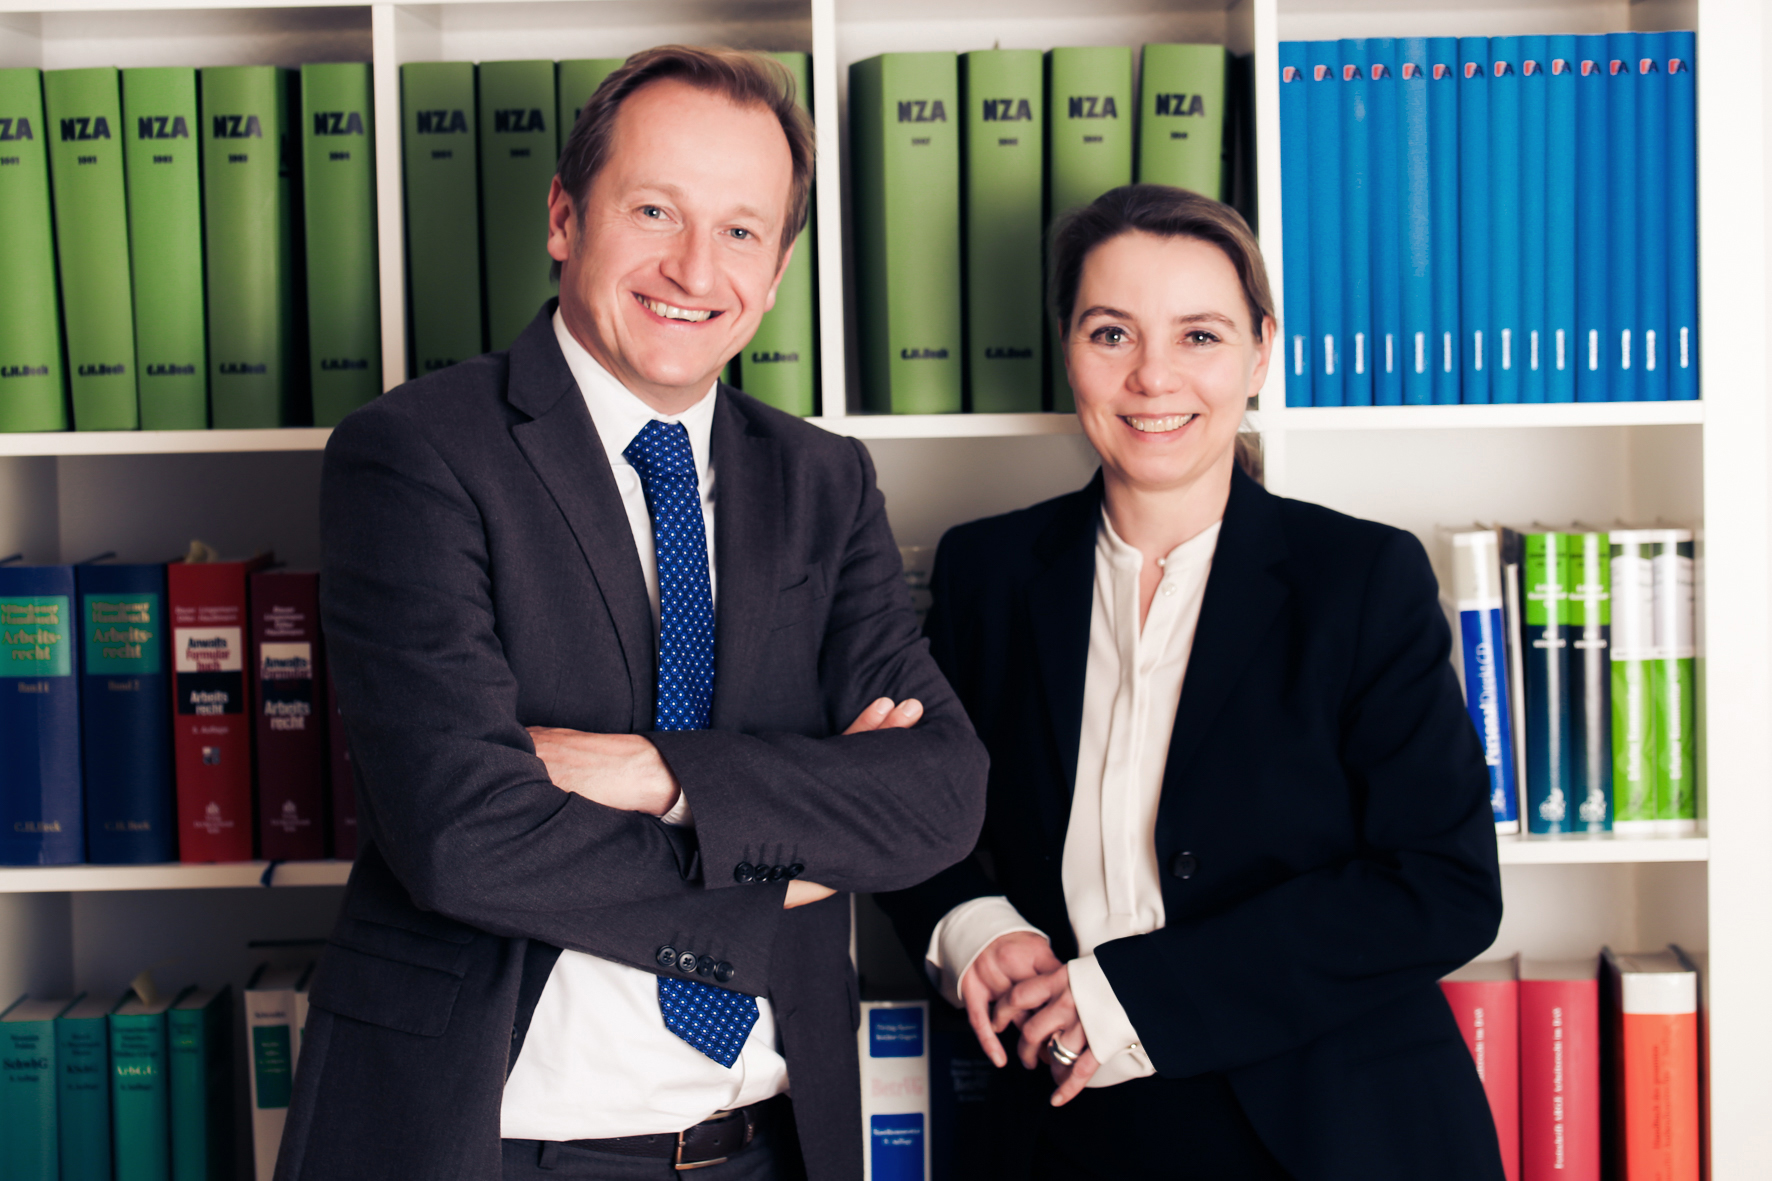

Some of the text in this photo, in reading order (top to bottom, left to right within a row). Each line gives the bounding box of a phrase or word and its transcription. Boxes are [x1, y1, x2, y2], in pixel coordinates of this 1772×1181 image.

[897, 100, 947, 123] NZA
[983, 99, 1032, 121] NZA
[1069, 96, 1118, 118] NZA
[1156, 93, 1204, 116] NZA
[0, 118, 33, 141] ZA
[60, 117, 111, 141] NZA
[138, 116, 189, 139] NZA
[213, 115, 262, 138] NZA
[314, 112, 364, 135] NZA
[417, 110, 467, 134] NZA
[495, 109, 546, 133] NZA
[12, 645, 51, 660] recht
[103, 643, 142, 659] recht
